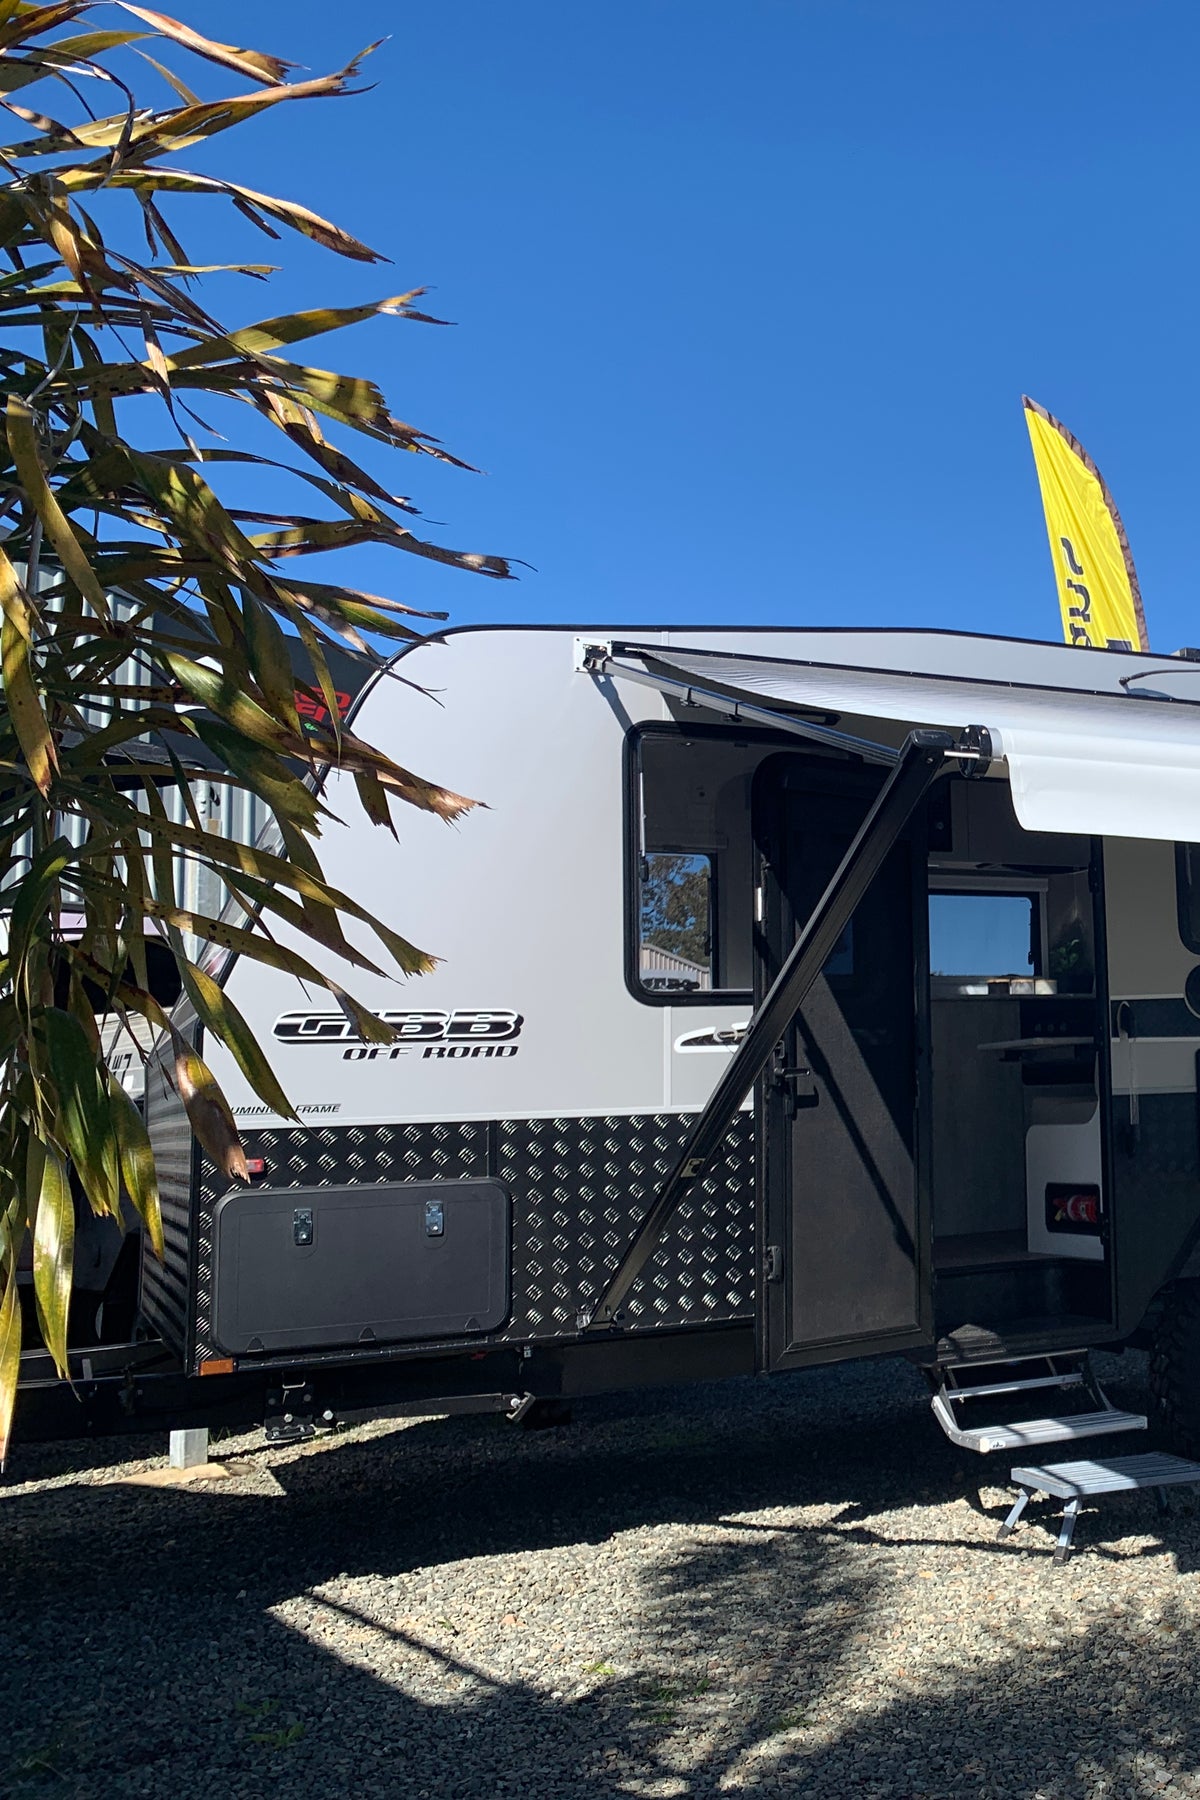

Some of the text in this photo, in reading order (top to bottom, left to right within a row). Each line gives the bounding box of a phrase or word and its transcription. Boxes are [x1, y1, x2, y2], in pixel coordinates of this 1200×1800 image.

[342, 1046, 519, 1061] OFF ROAD
[295, 1103, 341, 1113] FRAME
